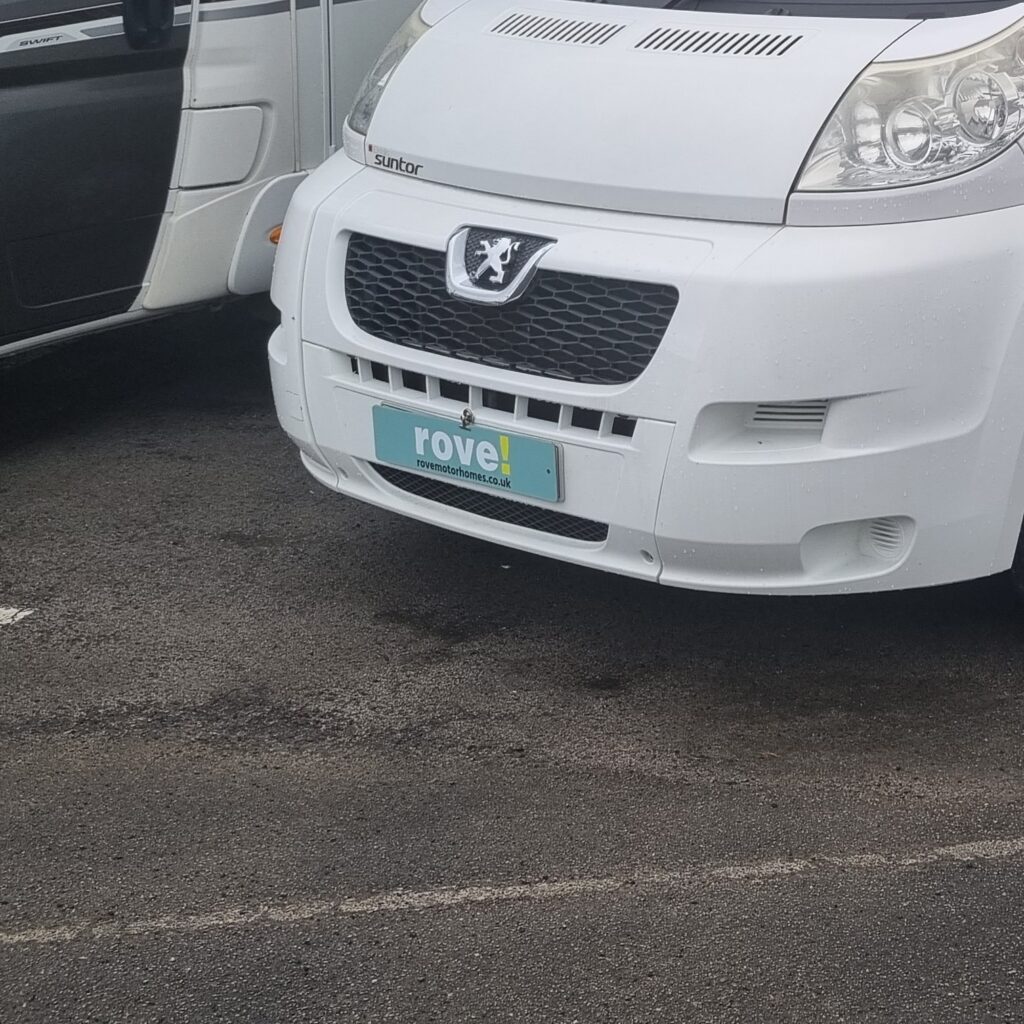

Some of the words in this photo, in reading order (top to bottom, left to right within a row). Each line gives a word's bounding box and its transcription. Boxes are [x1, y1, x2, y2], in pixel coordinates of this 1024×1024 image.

[19, 35, 63, 47] SWIFT
[374, 154, 424, 176] suntor
[414, 425, 511, 476] rove!
[416, 458, 512, 489] rovemotorhomes.co.uk
